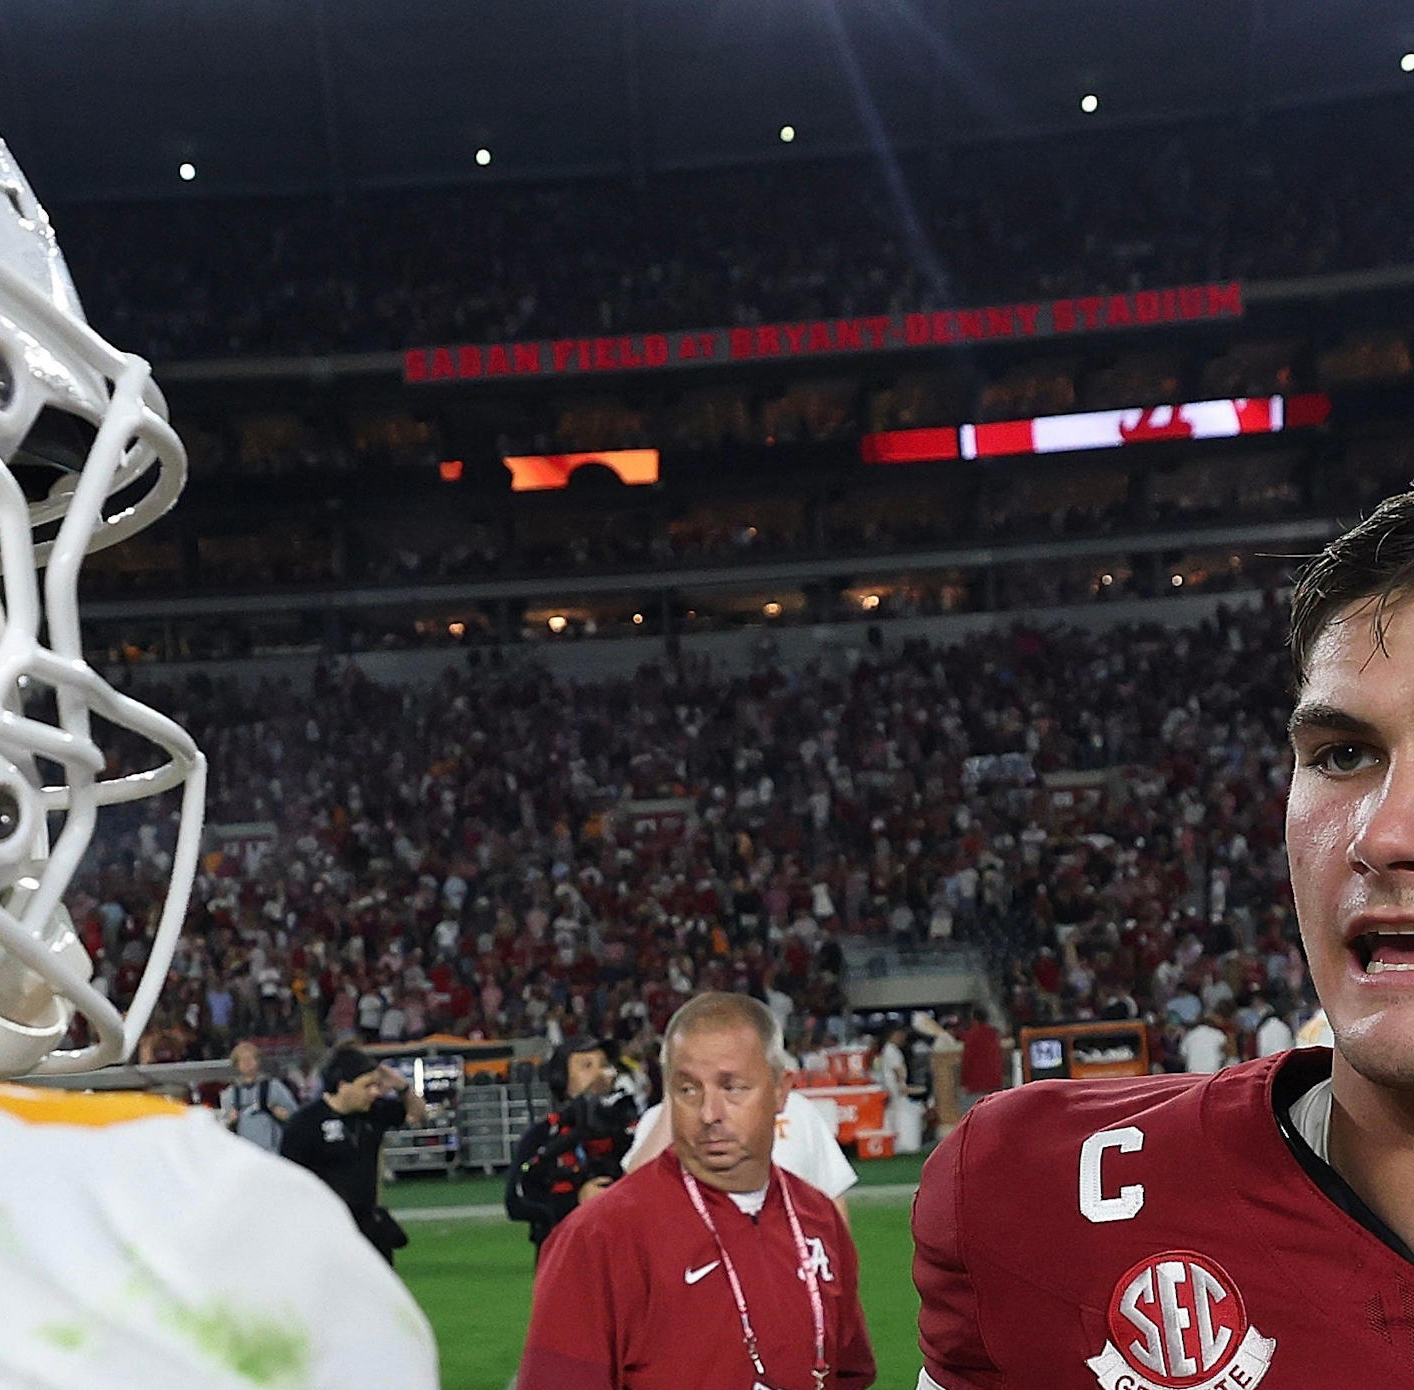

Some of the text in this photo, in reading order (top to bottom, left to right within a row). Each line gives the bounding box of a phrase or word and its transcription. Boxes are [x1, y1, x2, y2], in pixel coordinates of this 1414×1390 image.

[404, 282, 1243, 382] SABAN FIELD AT BRYANT-DENNY STADIUM
[1079, 1126, 1144, 1223] C
[1119, 1261, 1234, 1378] SEC
